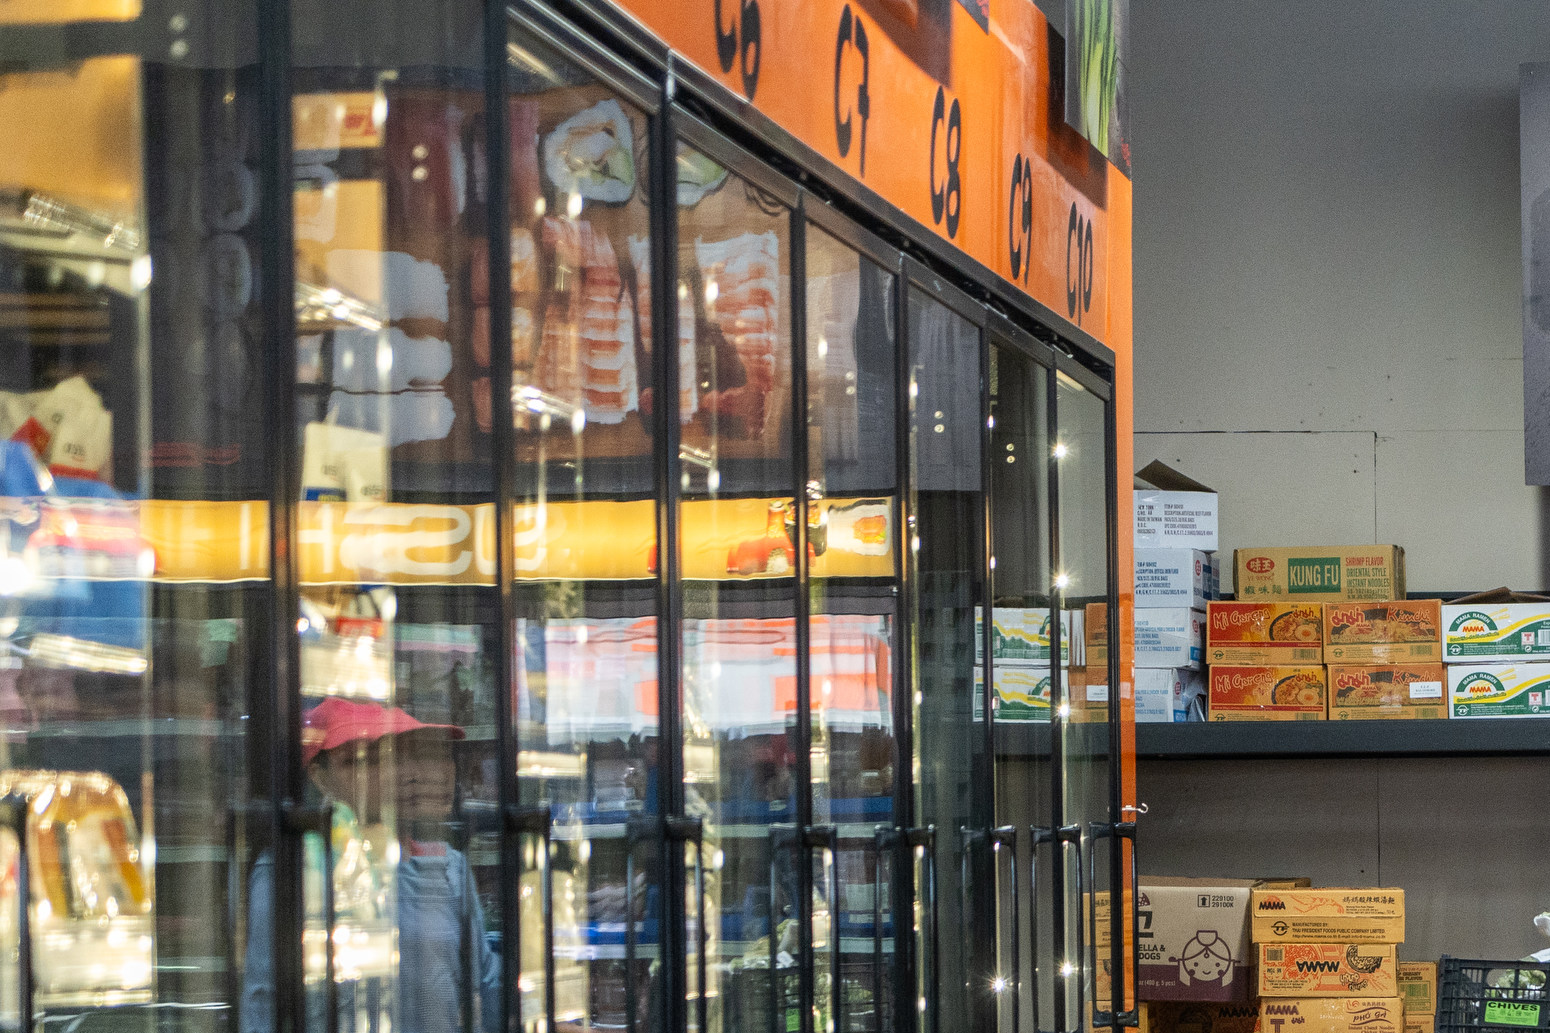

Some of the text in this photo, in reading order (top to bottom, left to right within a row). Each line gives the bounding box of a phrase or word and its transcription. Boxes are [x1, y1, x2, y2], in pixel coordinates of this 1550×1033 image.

[834, 4, 870, 178] C7
[930, 85, 961, 239] C8
[1009, 152, 1032, 287] C9
[1067, 201, 1093, 327] C10
[1345, 556, 1384, 567] SHRIMP FLAVOR
[1290, 564, 1339, 587] KUNG FU
[1346, 567, 1387, 578] ORIENTAL STYLE
[1346, 578, 1390, 588] INSTANT NOODLES
[1230, 608, 1271, 626] Goreng
[1386, 605, 1430, 623] Kimchi
[1456, 613, 1491, 624] MAMA RAMEN
[1462, 625, 1485, 633] MAMA
[1232, 671, 1273, 690] Goreng
[1259, 901, 1286, 910] MAMA
[1296, 961, 1340, 973] MAMA
[1266, 1005, 1299, 1015] MAMA
[1487, 1001, 1538, 1011] CHIVES
[1219, 1007, 1259, 1018] MAMA
